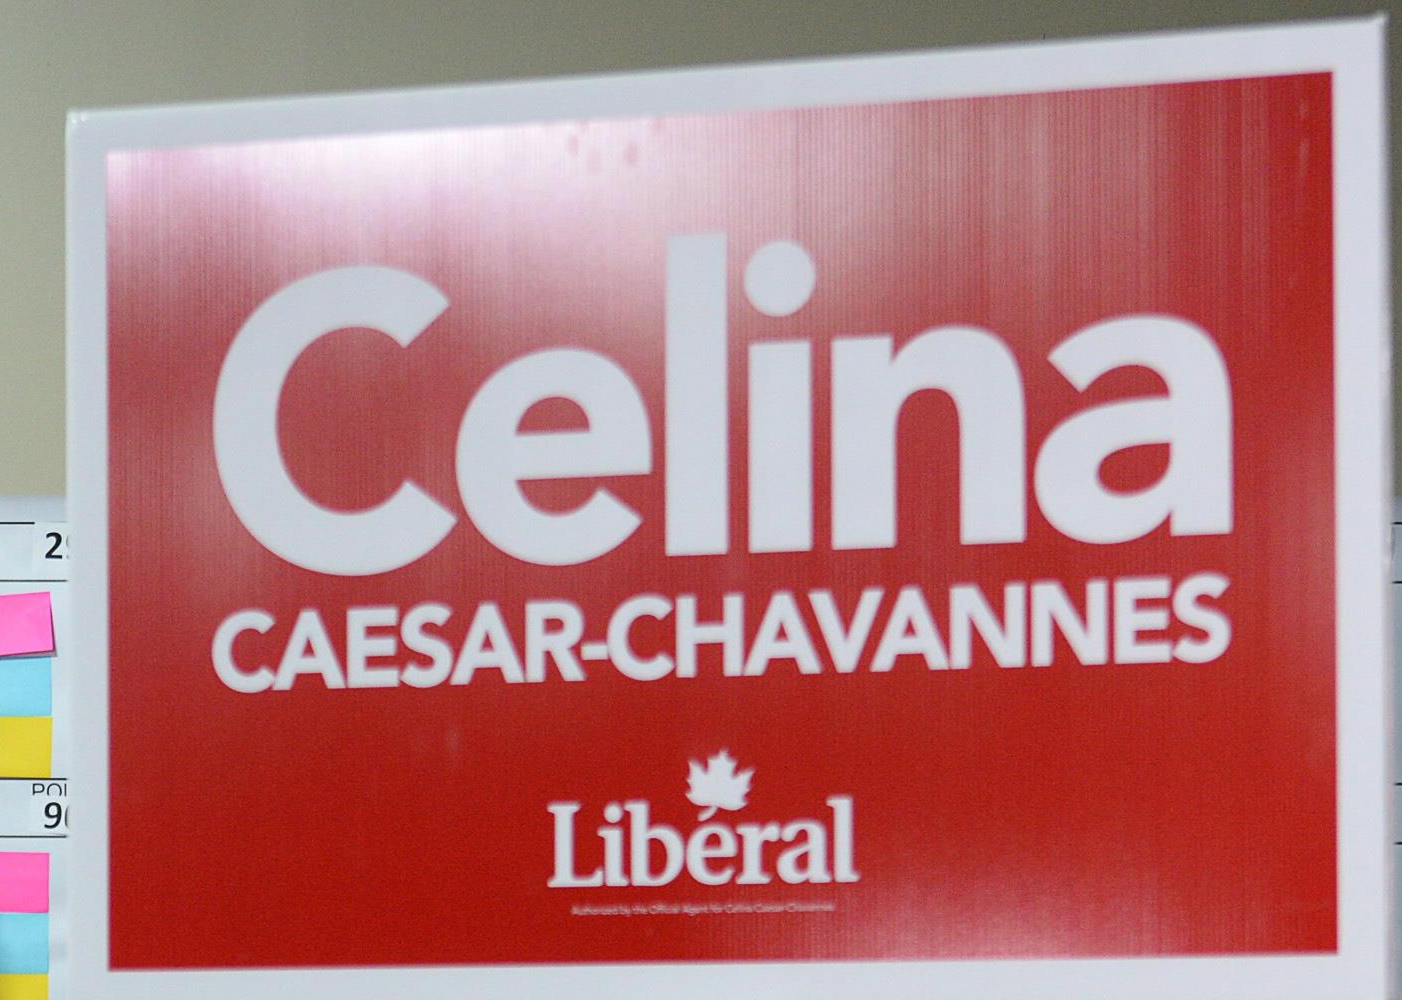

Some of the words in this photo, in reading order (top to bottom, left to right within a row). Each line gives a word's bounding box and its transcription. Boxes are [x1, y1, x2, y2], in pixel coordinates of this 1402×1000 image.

[211, 230, 1234, 577] Celina
[44, 531, 70, 560] 2
[209, 572, 1232, 695] CAESAR-CHAVANNES
[43, 801, 70, 830] 9
[547, 795, 861, 888] Libéral
